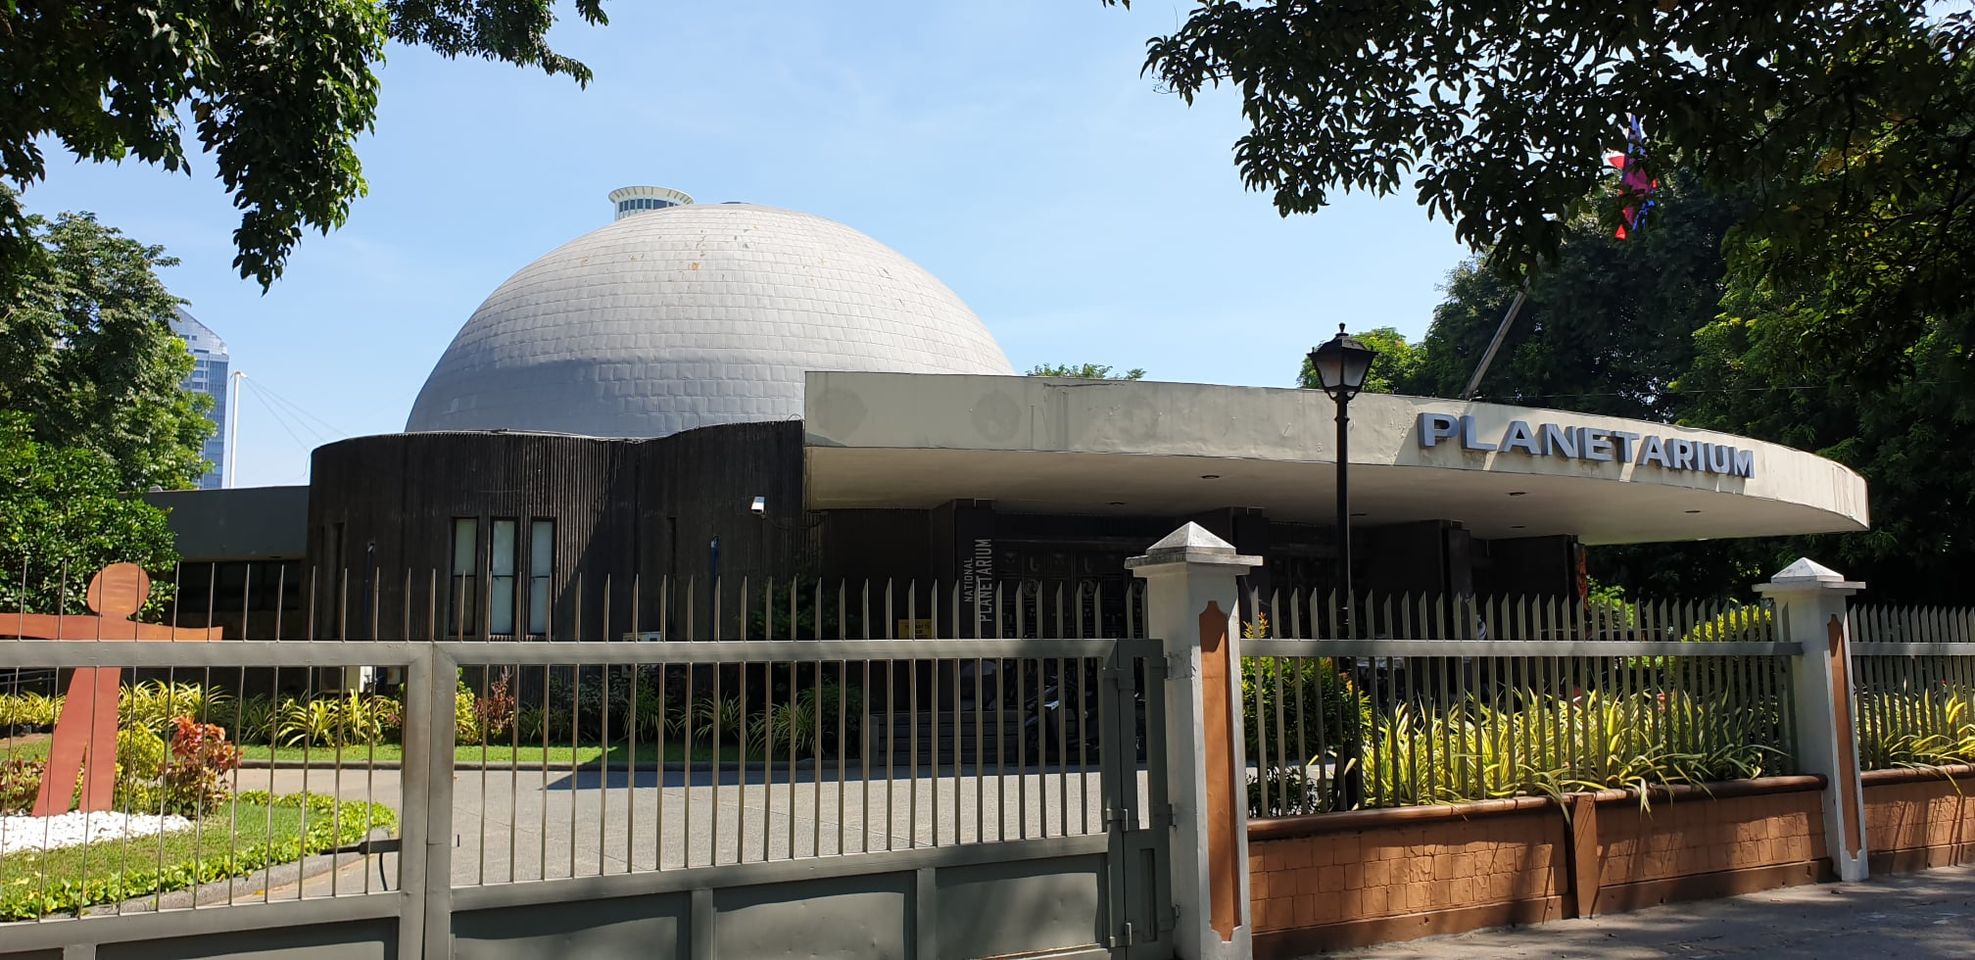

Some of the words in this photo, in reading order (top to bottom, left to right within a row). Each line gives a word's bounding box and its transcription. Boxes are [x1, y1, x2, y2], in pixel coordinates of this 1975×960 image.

[1418, 412, 1755, 479] PLANETARIUM
[964, 557, 974, 602] NATIONAL
[975, 538, 992, 622] PLANETARIUM
